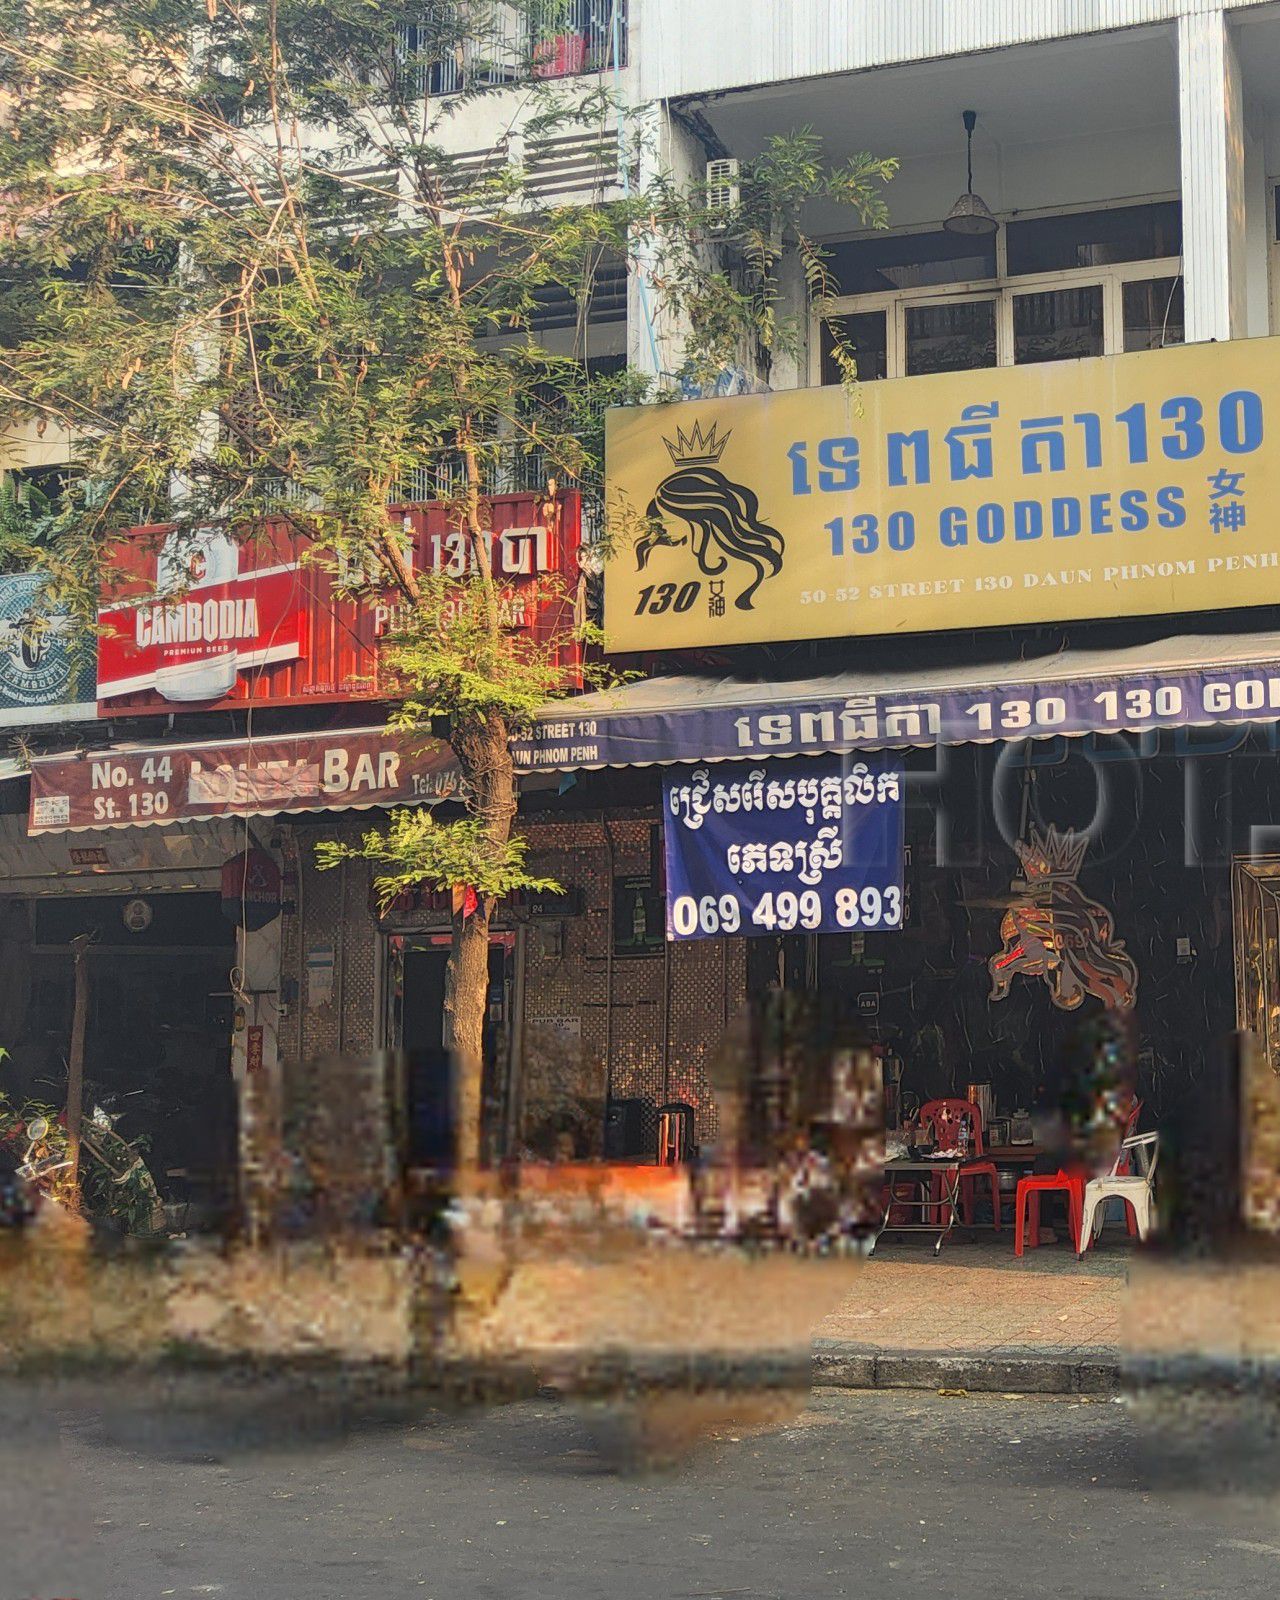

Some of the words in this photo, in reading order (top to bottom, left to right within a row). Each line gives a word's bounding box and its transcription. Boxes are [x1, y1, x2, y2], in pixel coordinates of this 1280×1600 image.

[824, 510, 916, 557] 130
[939, 486, 1187, 547] GODDESS
[1207, 468, 1246, 534] 女神
[633, 580, 701, 616] 130
[800, 587, 861, 605] 50-52
[869, 578, 965, 600] STREET
[974, 574, 1013, 592] 130
[1022, 566, 1093, 589] DAUN
[1102, 557, 1196, 580] PHNOM
[1206, 551, 1280, 572] PENH
[136, 598, 259, 648] CAMBODIA
[163, 646, 204, 657] PREMIUM
[206, 644, 230, 654] BEER
[536, 722, 576, 740] STREET
[578, 720, 597, 737] 130
[964, 697, 1067, 732] 130
[1094, 686, 1183, 721] 130
[91, 761, 134, 790] No.
[141, 756, 173, 785] 44
[323, 749, 401, 793] BAR
[534, 747, 569, 765] PHNOM
[571, 745, 598, 762] PENH
[93, 795, 121, 820] St.
[128, 791, 169, 818] 130
[673, 893, 741, 936] 069
[752, 889, 823, 931] 499
[834, 885, 901, 928] 893
